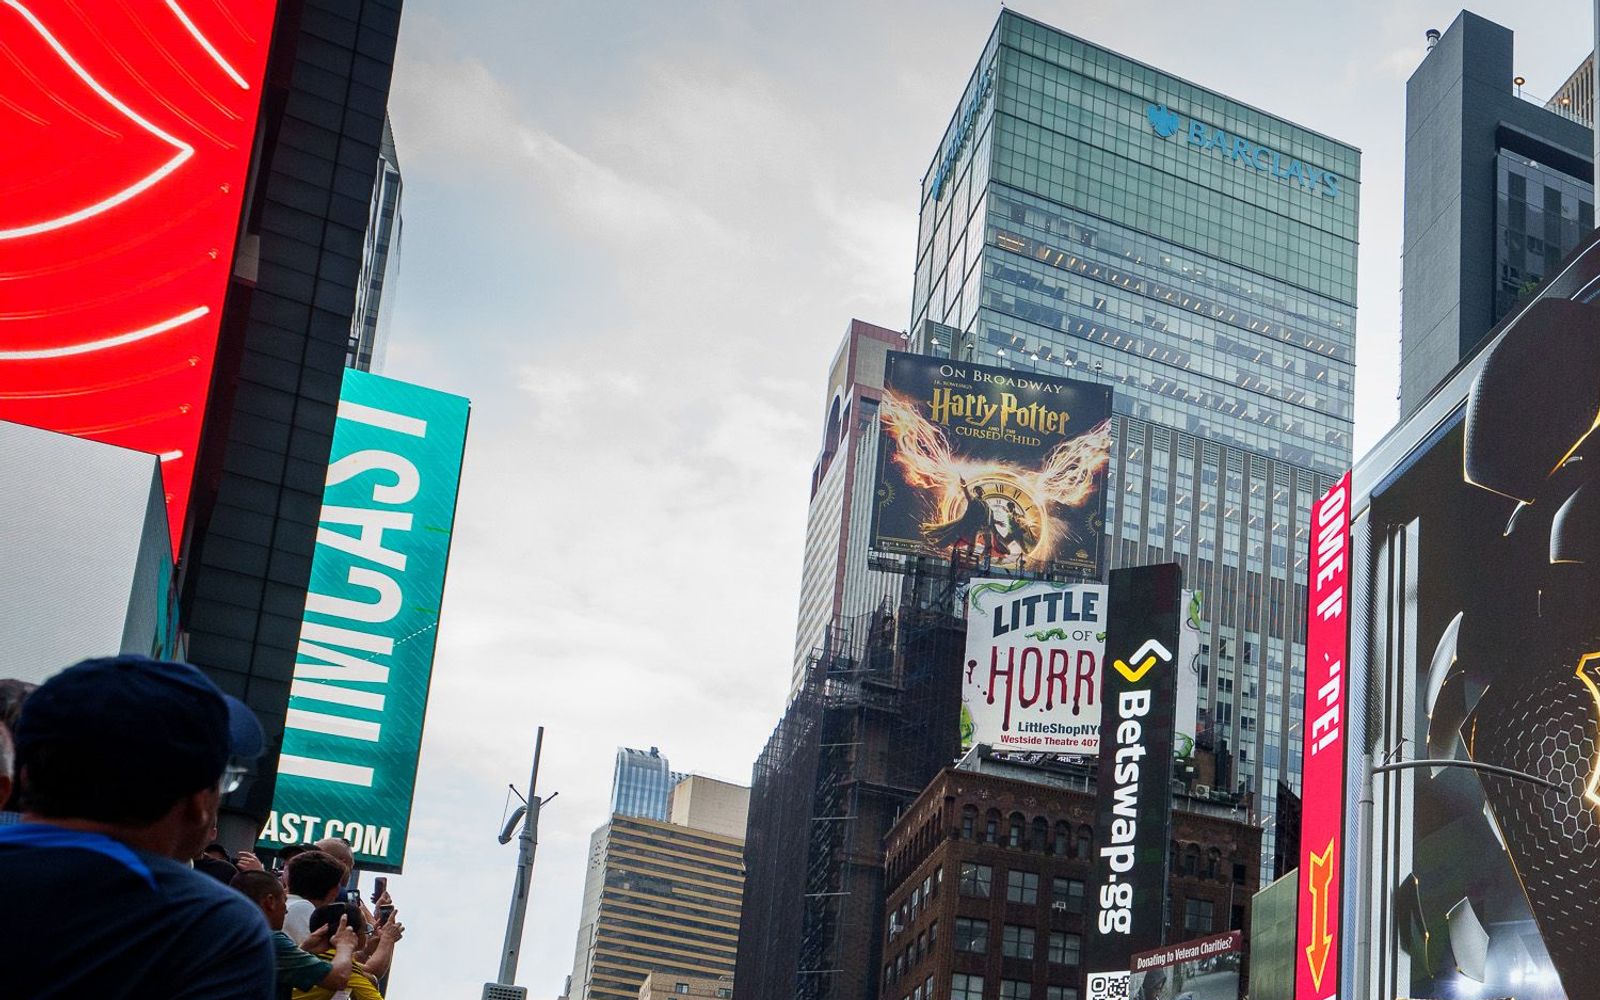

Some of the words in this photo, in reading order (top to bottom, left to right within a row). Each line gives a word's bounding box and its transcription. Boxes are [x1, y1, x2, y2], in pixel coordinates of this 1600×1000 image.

[1188, 119, 1340, 199] BARCLAYS
[939, 364, 966, 379] ON
[973, 370, 1064, 394] BROADWAY
[927, 388, 998, 428] Harry
[1000, 392, 1071, 436] Potter
[955, 427, 1001, 441] CURSED
[1004, 434, 1041, 447] CHILD
[993, 591, 1099, 638] LITTLE
[1072, 630, 1093, 641] OF
[986, 645, 1105, 732] HORR
[1000, 734, 1042, 745] Westside
[1044, 737, 1079, 746] Theatre
[1081, 738, 1098, 747] 407
[1098, 689, 1152, 935] Betswap.gg
[1137, 953, 1166, 970] Donating
[1166, 952, 1174, 963] to
[1175, 946, 1200, 960] Veteran
[1200, 936, 1233, 955] Charities?
